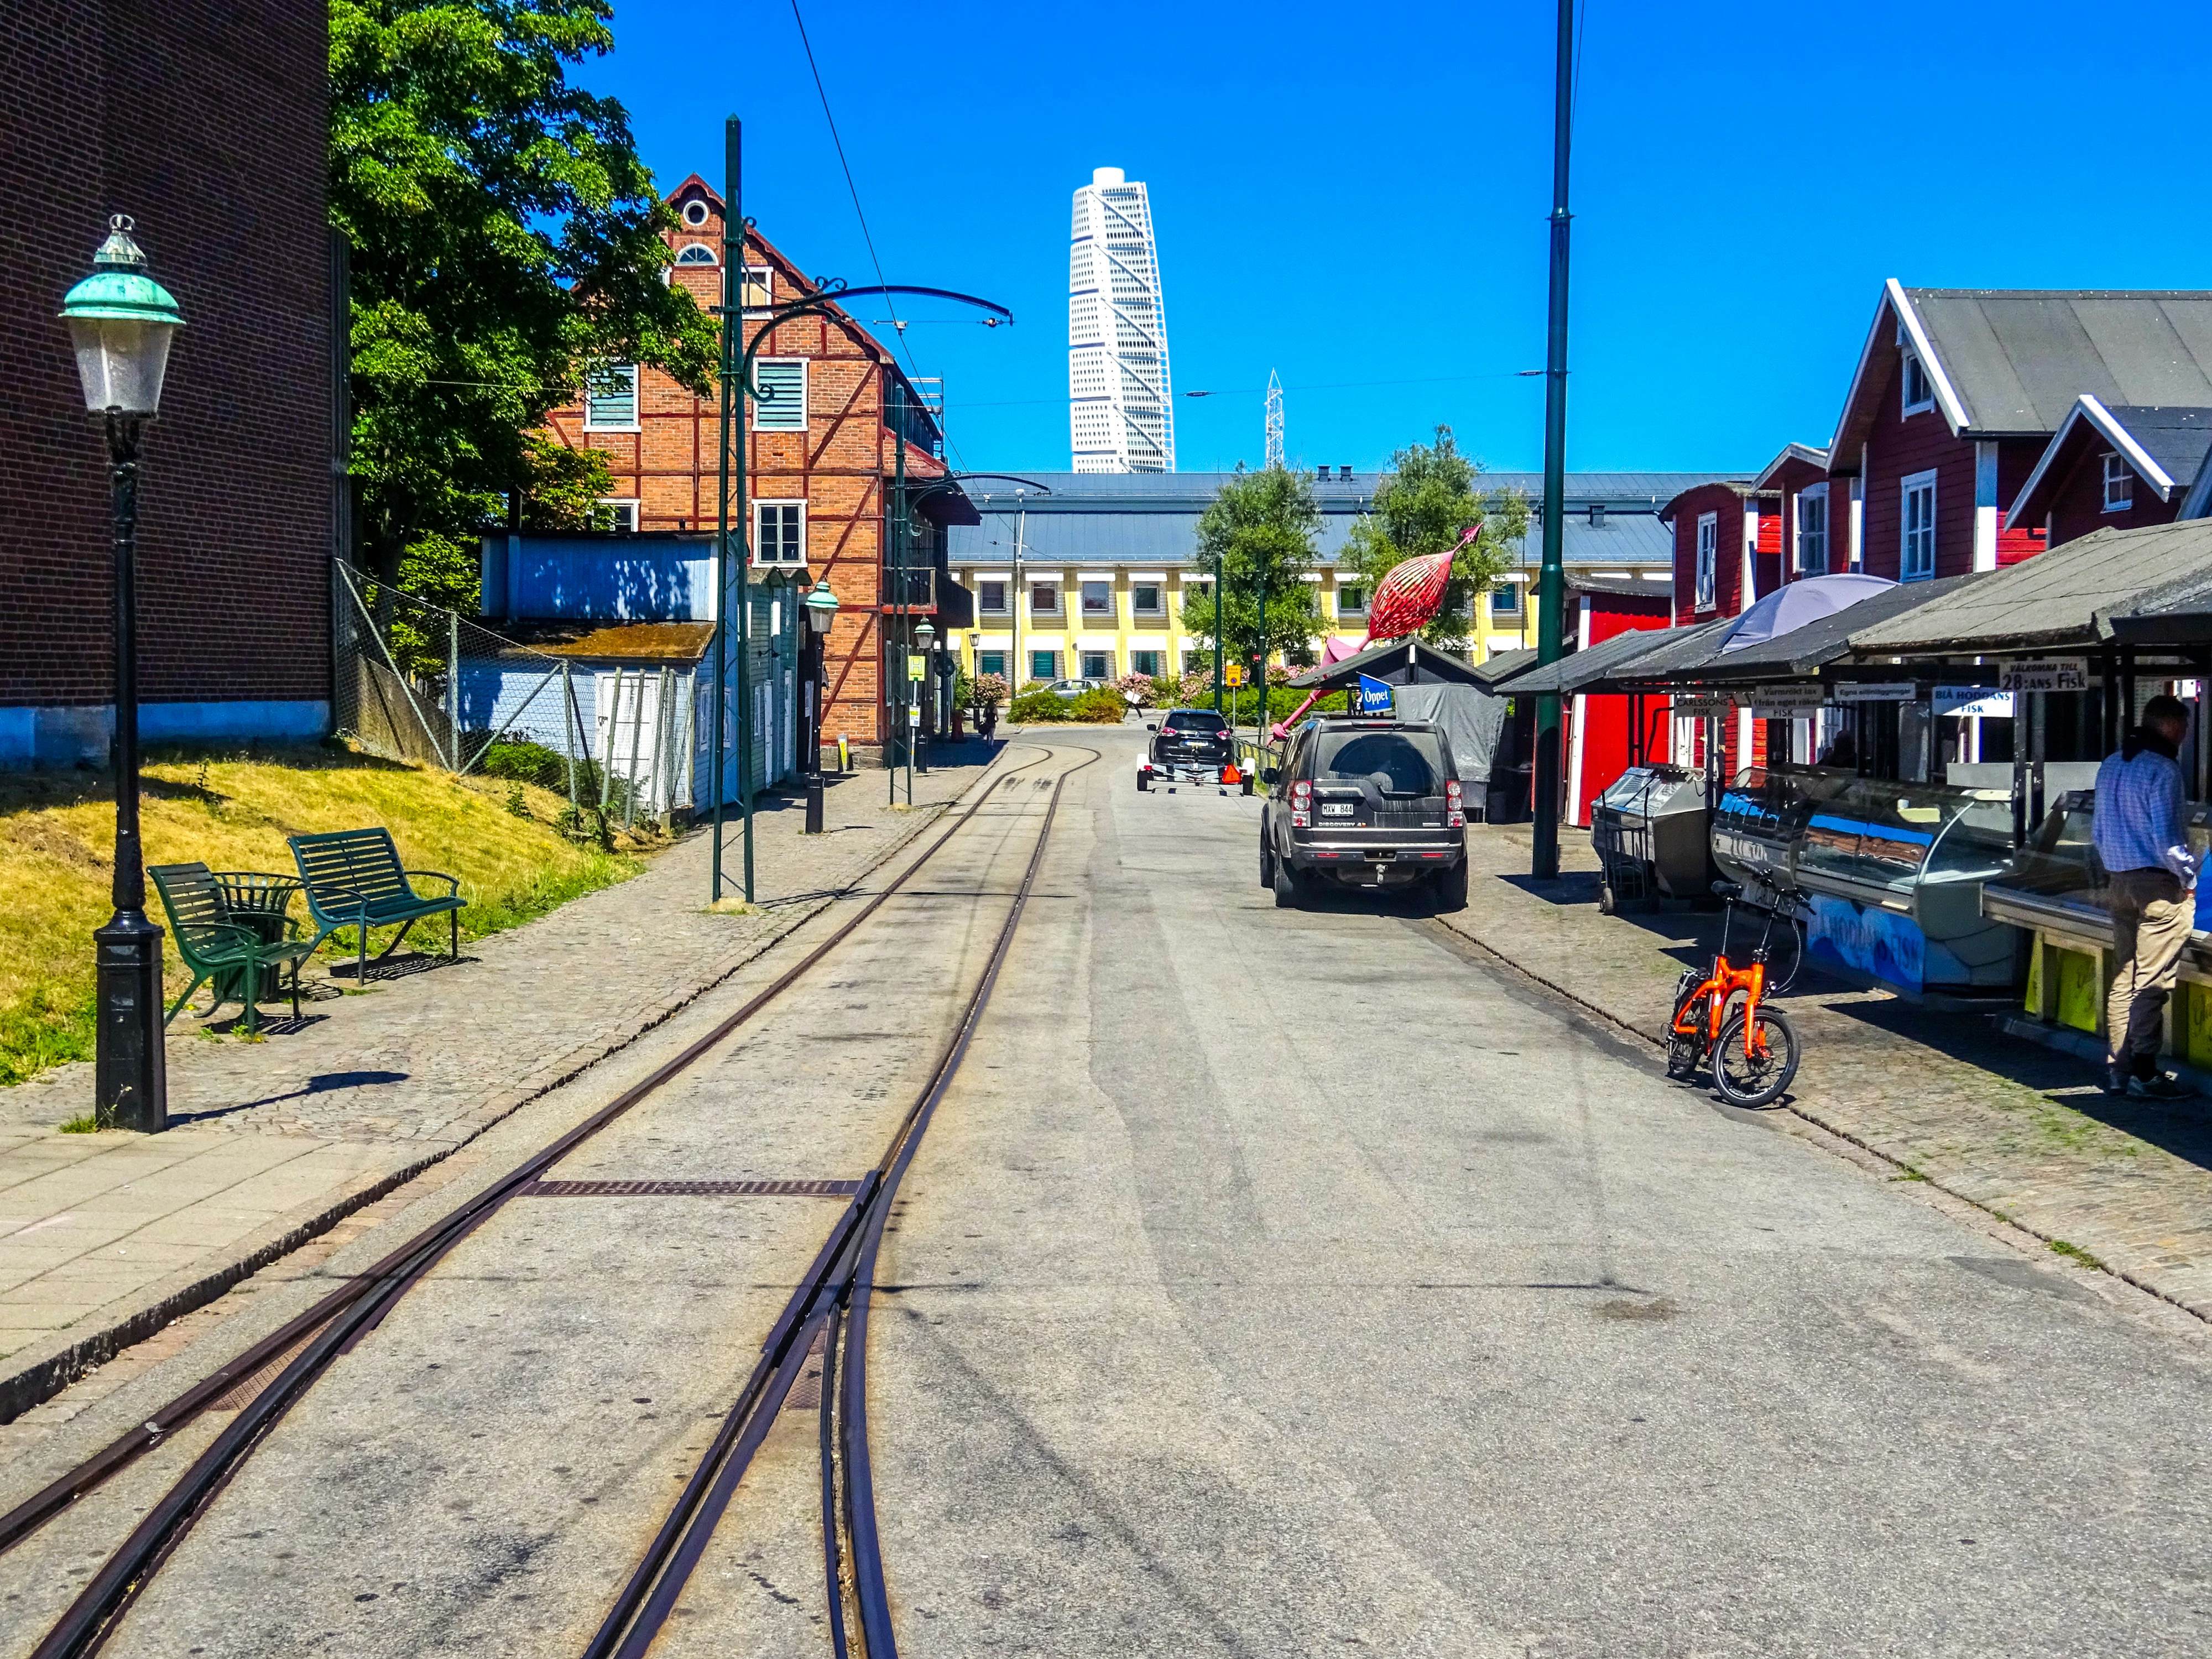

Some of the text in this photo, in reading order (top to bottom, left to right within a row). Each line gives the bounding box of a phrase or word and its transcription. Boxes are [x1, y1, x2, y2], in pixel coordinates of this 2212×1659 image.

[2060, 662, 2078, 671] TILL
[2057, 671, 2086, 688] Fisk
[1364, 687, 1389, 705] Öppet
[1676, 698, 1728, 707] CARLSSONS
[1777, 698, 1797, 707] eget
[1773, 708, 1794, 717] FISK
[1961, 705, 1984, 713] FISK
[1323, 805, 1352, 813] MXW 844
